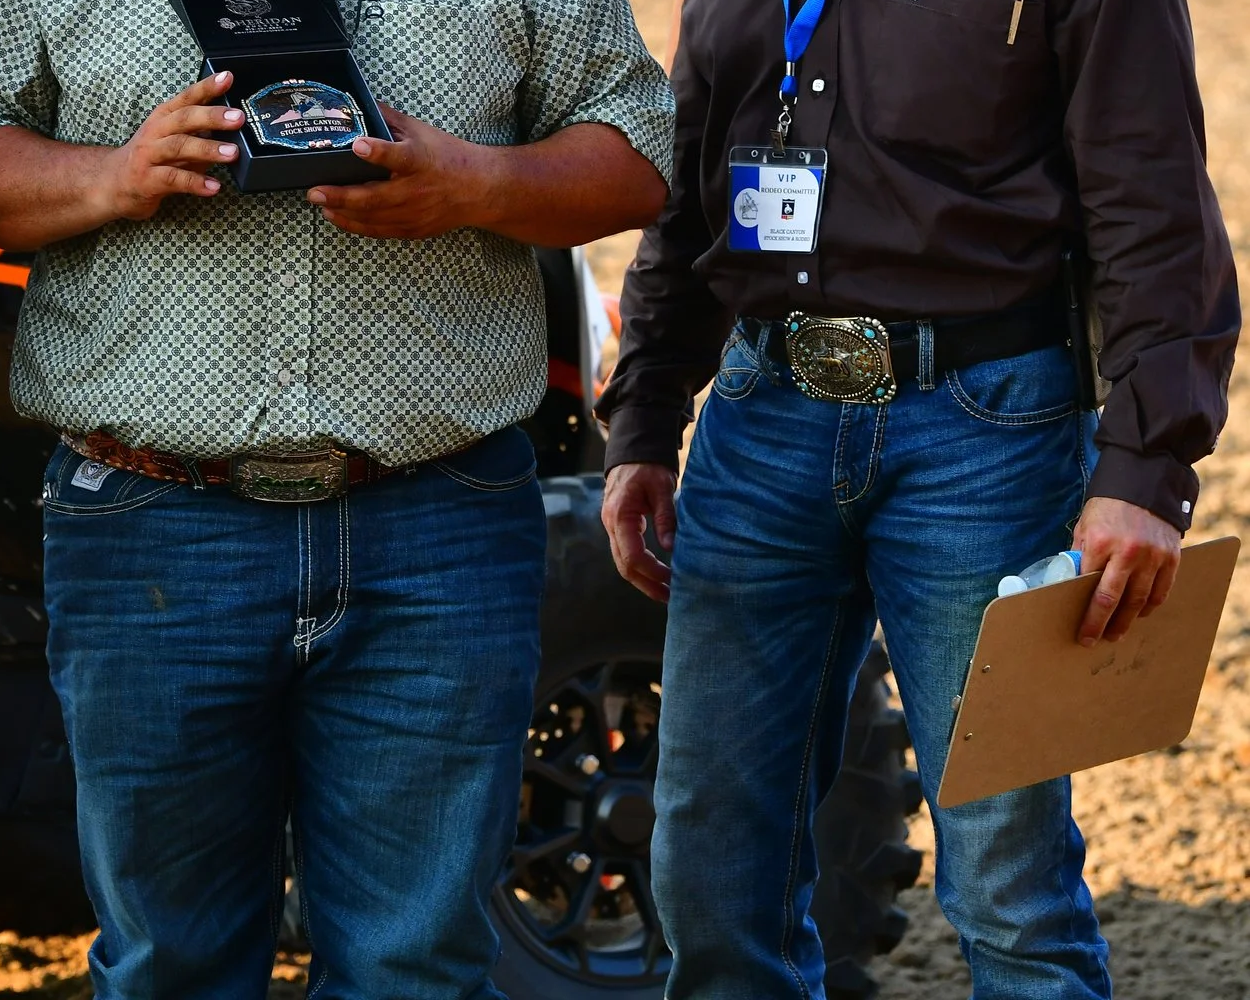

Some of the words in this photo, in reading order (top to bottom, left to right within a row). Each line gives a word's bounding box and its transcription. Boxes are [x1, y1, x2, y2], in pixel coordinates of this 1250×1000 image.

[217, 16, 302, 30] SHERIDAN
[284, 120, 310, 129] BLACK
[280, 128, 304, 137] STOCK
[778, 173, 797, 183] VIP
[783, 187, 816, 195] COMMITTEE
